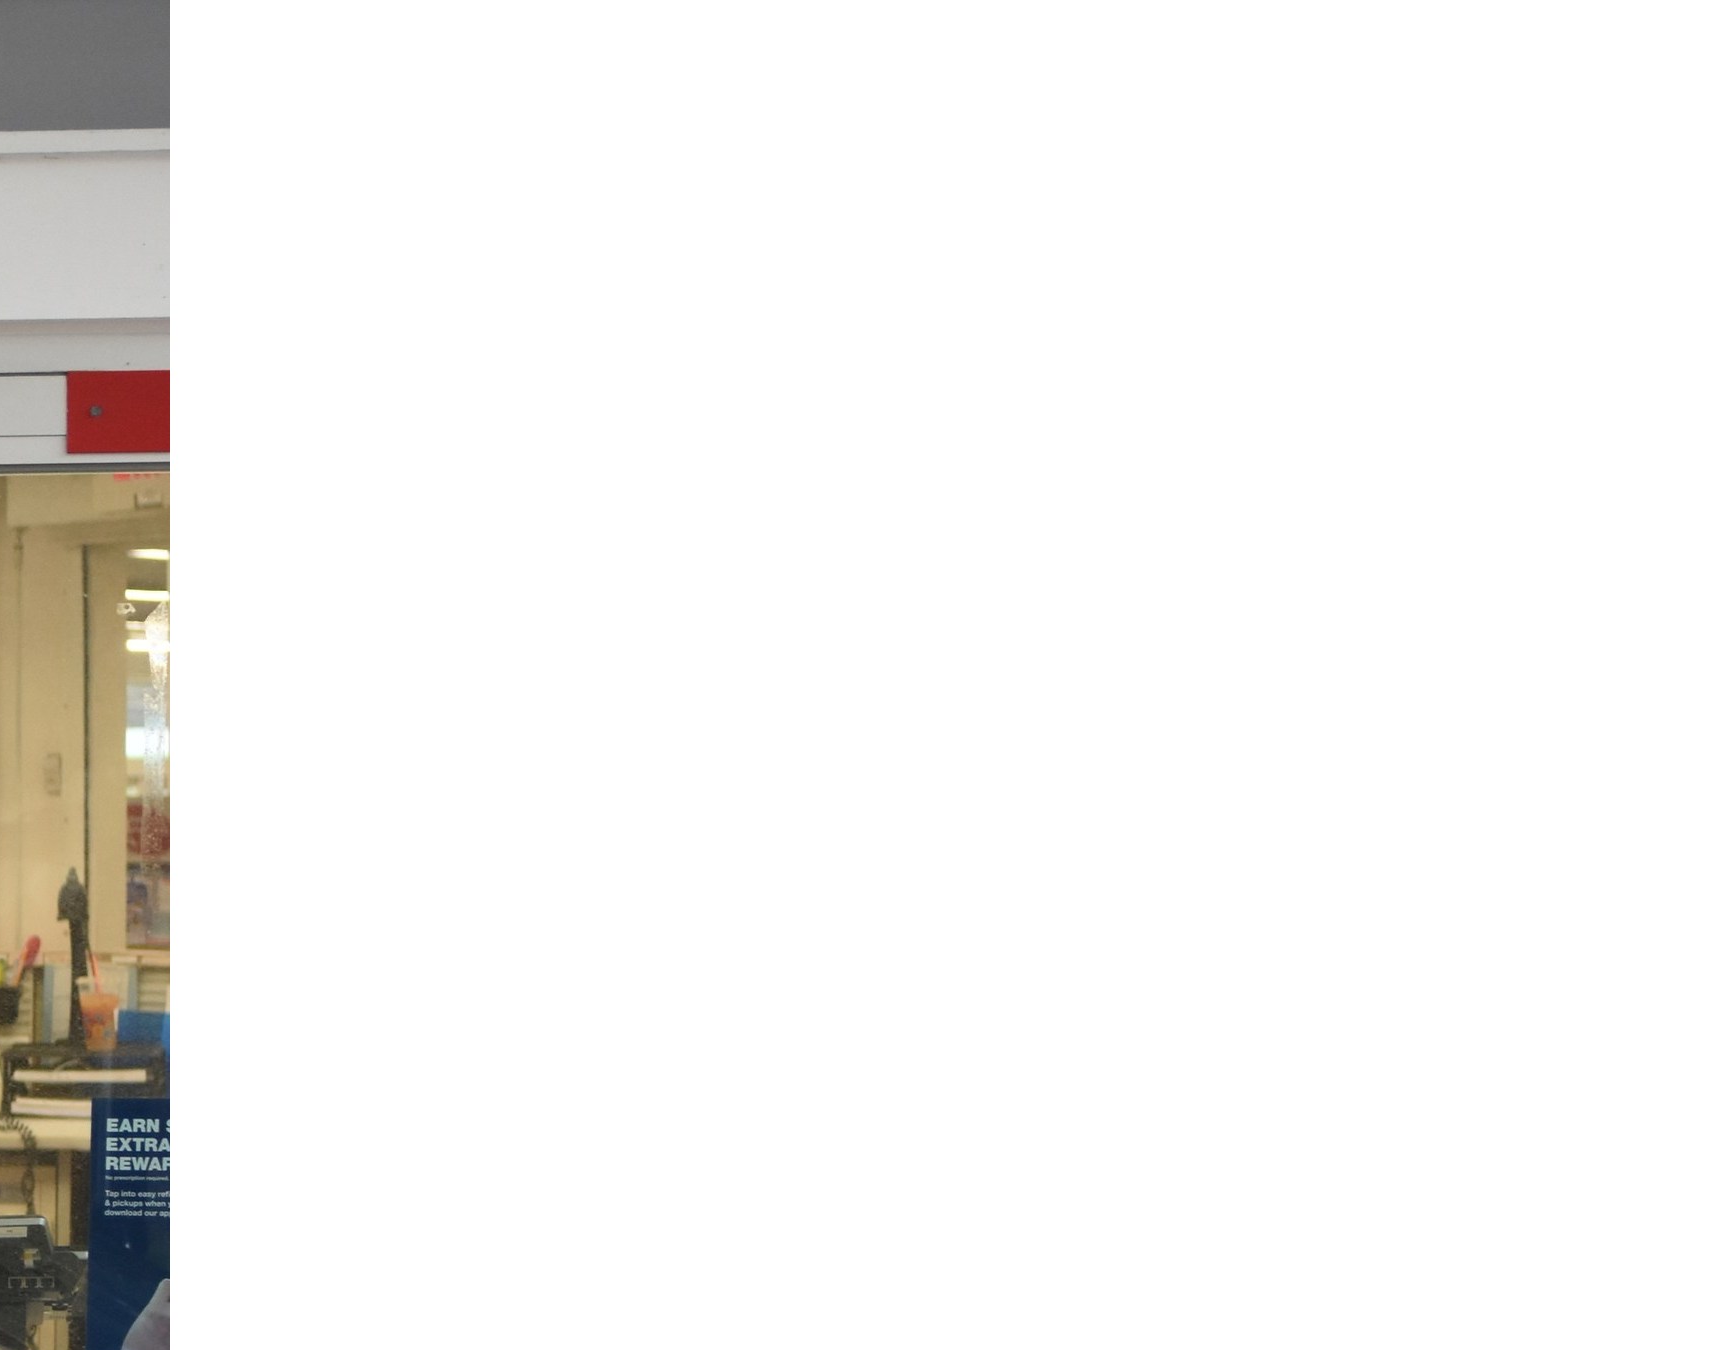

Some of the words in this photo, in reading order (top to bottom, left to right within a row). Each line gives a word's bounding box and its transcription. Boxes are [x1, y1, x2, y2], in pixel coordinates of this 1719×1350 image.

[106, 1118, 160, 1133] EARN
[106, 1137, 170, 1152] EXTRA
[105, 1190, 120, 1199] Tap
[121, 1190, 136, 1198] into
[137, 1191, 156, 1199] easy
[104, 1199, 111, 1207] &
[112, 1200, 144, 1208] pickups
[104, 1209, 143, 1217] download
